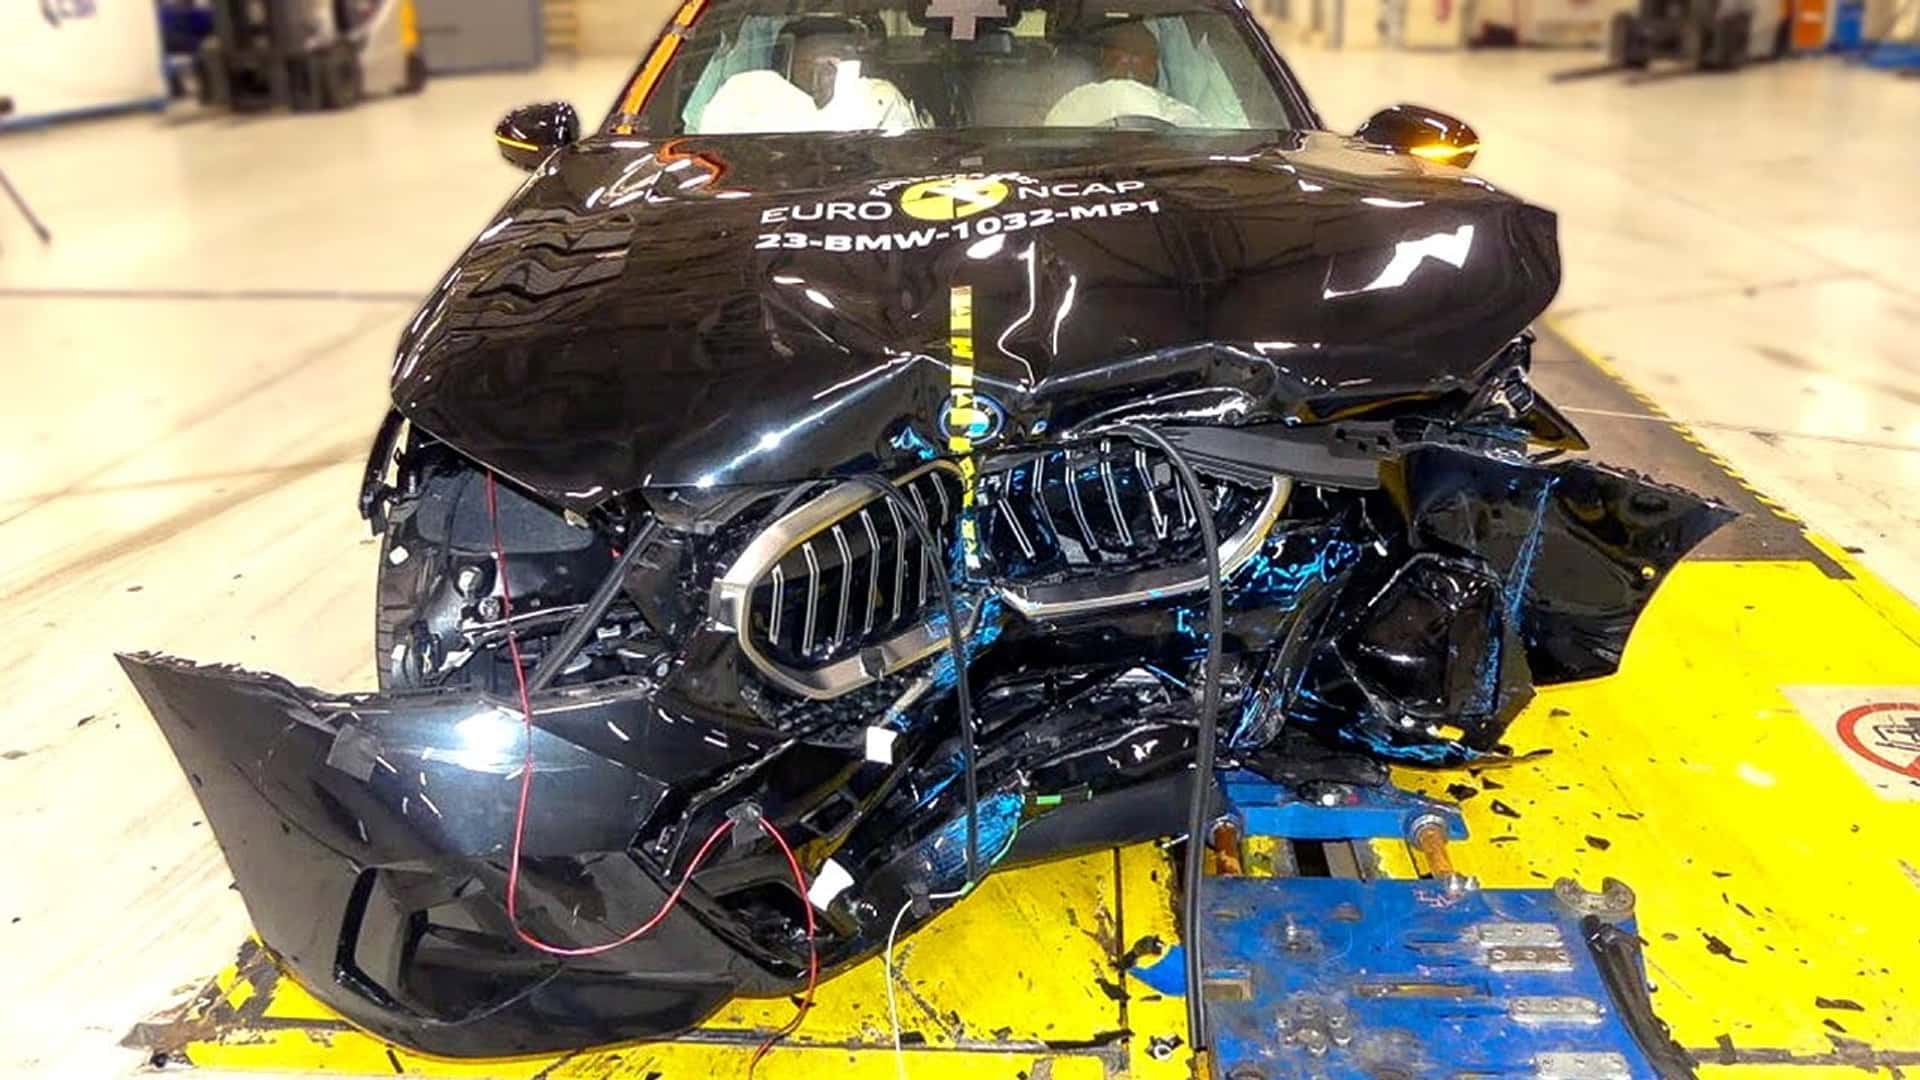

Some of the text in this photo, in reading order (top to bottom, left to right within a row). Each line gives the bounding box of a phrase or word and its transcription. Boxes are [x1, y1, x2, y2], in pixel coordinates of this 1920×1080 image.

[754, 200, 1160, 252] 23-BMW-1032-MP1
[760, 180, 1145, 224] EURO NCAP
